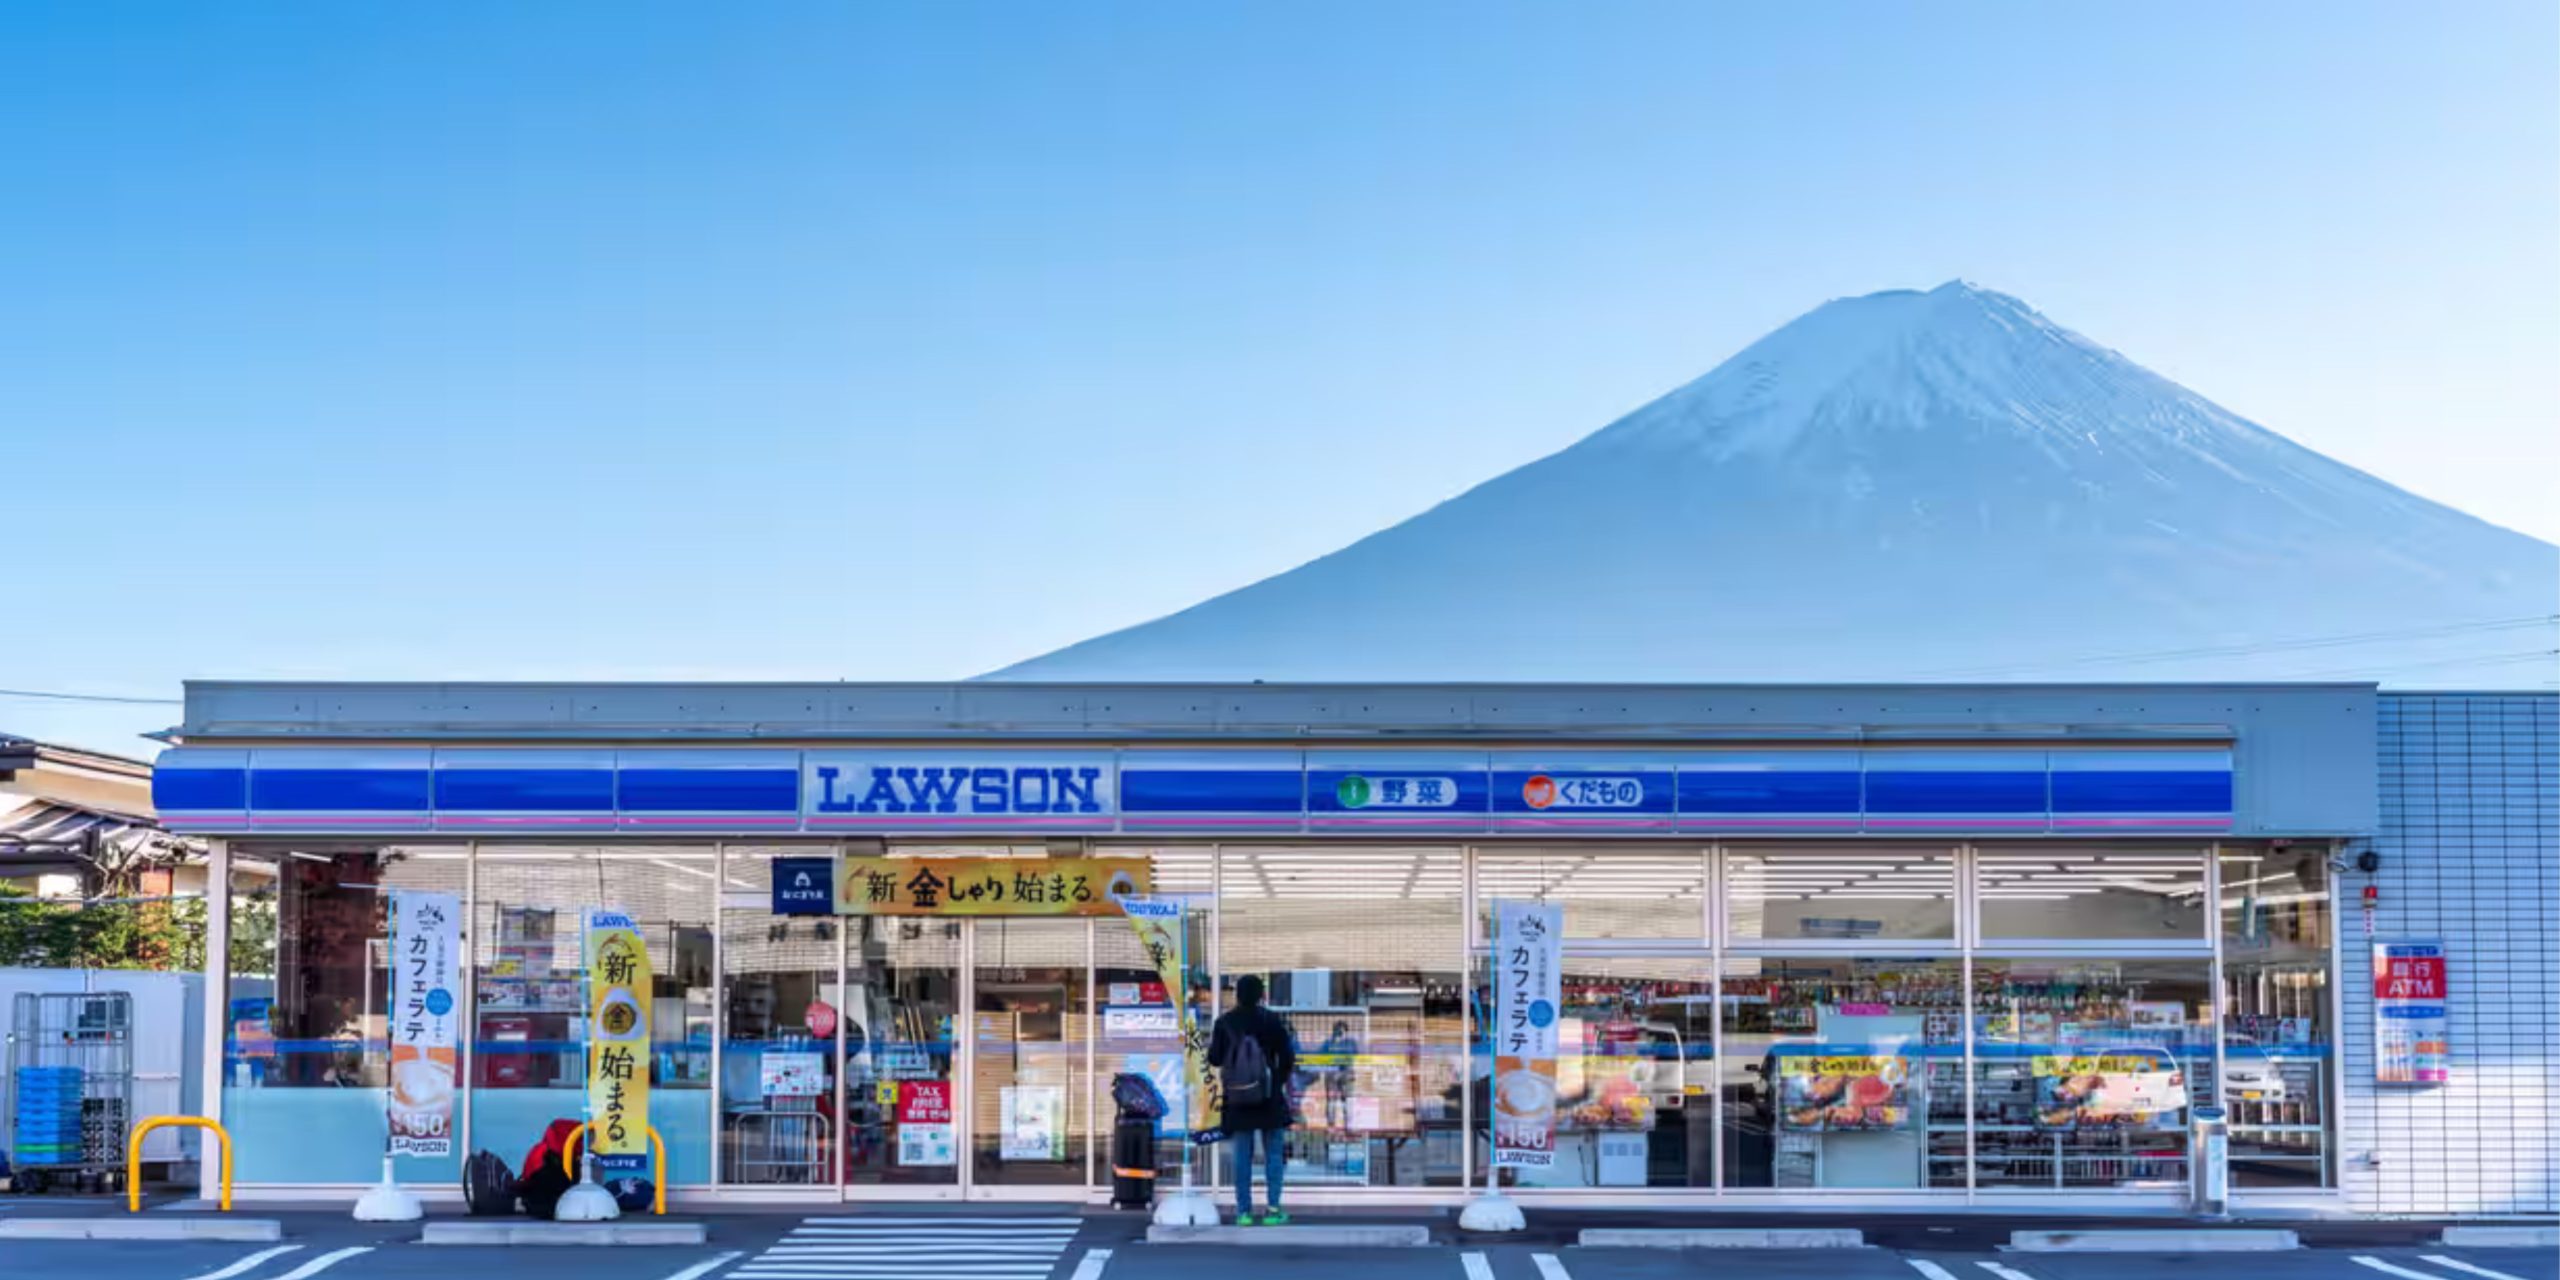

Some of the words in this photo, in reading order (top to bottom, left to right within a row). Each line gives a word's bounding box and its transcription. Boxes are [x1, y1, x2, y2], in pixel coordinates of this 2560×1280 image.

[817, 766, 1101, 813] LAWSON
[1381, 779, 1443, 803] 野菜
[1560, 780, 1638, 804] くだもの
[604, 952, 636, 985] 新
[2392, 961, 2430, 977] 銀行
[405, 934, 428, 1041] カフェラテ
[1510, 945, 1529, 1053] カフェラテ
[2388, 979, 2435, 996] ATM
[911, 1097, 944, 1109] FREE
[916, 1086, 941, 1097] TAX
